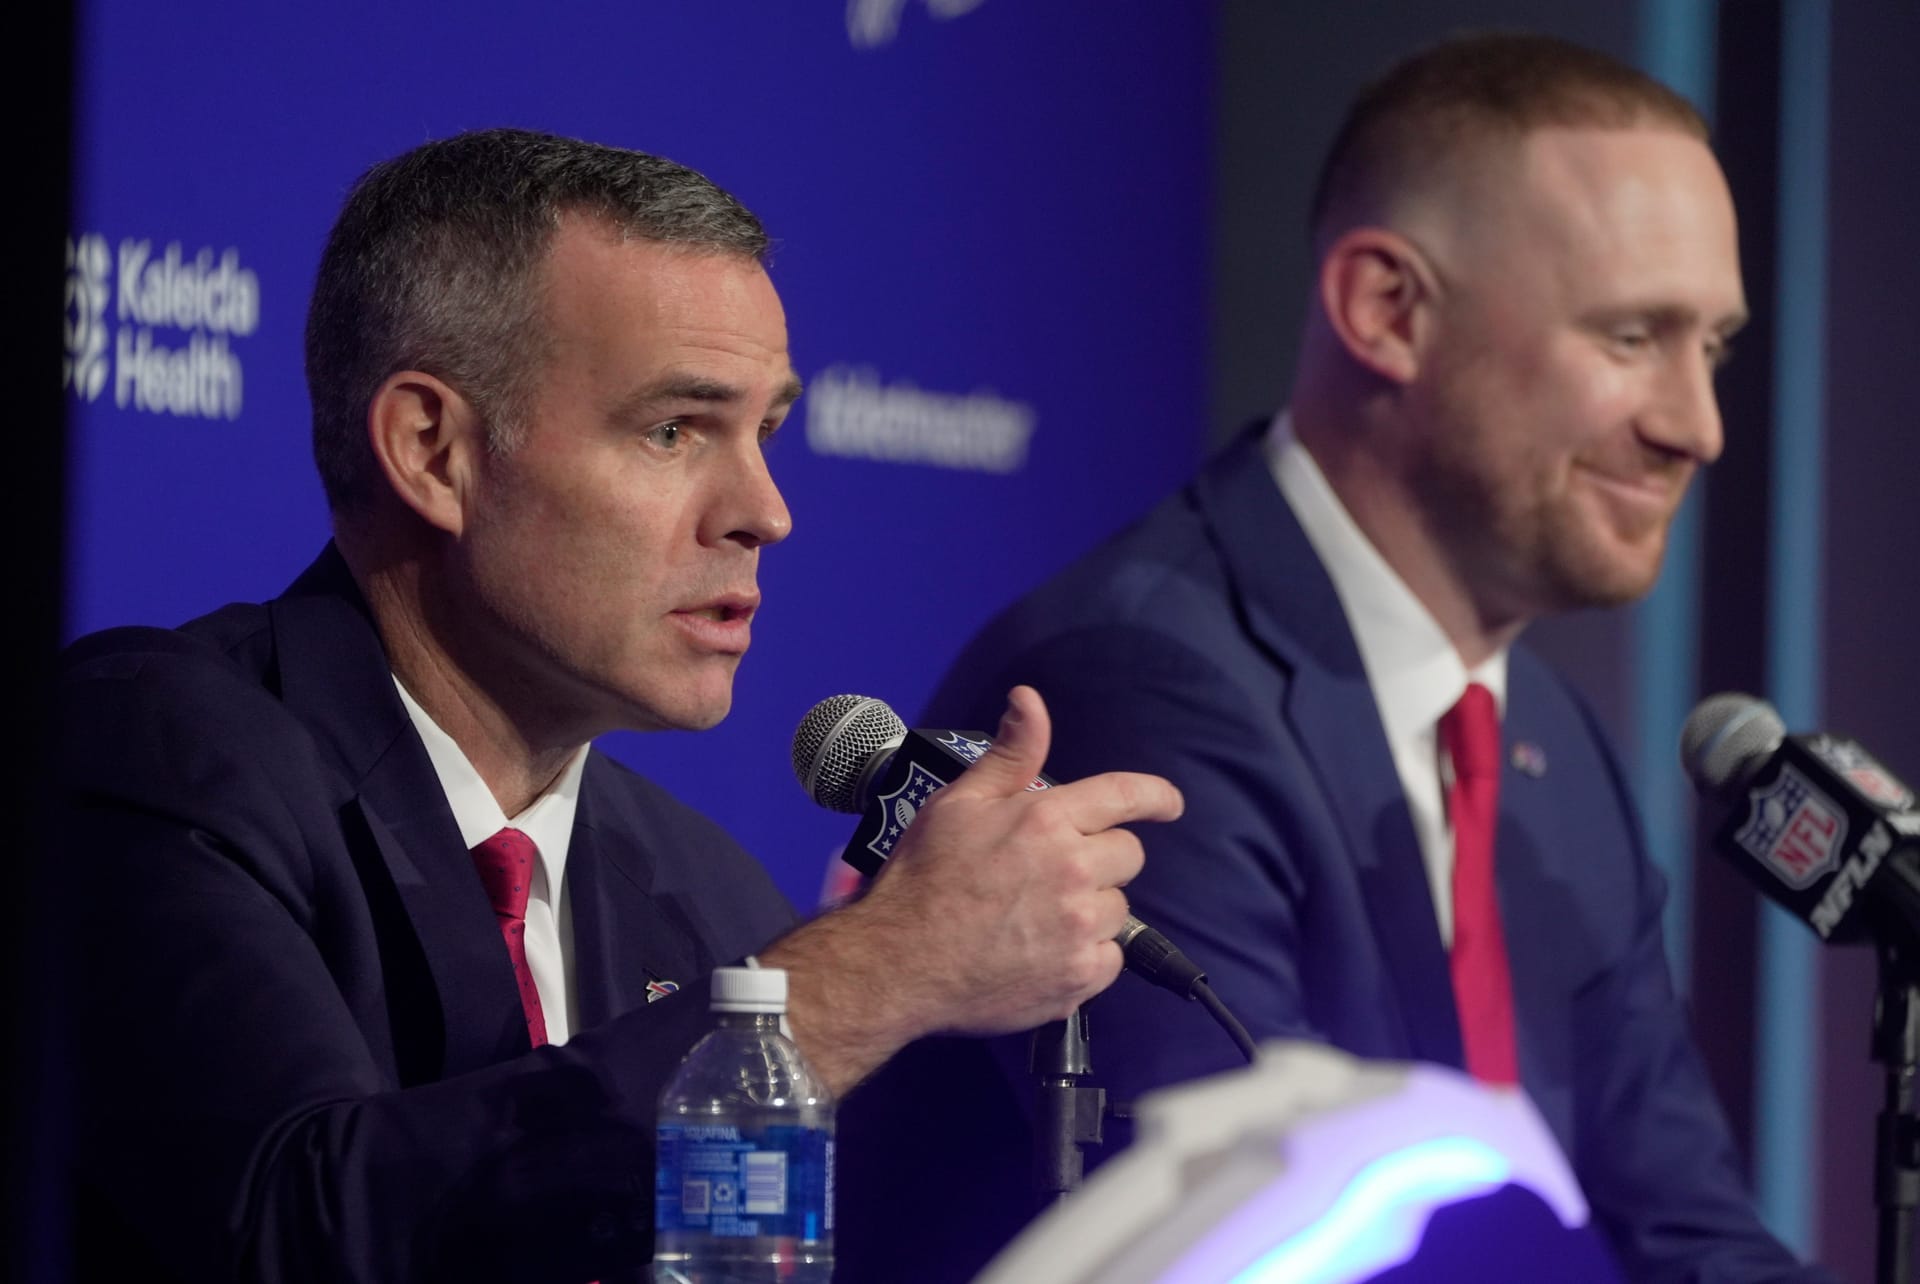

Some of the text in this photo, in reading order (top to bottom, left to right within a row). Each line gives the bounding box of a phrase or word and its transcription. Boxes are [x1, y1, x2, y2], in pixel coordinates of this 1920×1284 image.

[118, 238, 259, 337] Kaleida
[115, 325, 243, 421] Health
[1774, 805, 1839, 878] NFL
